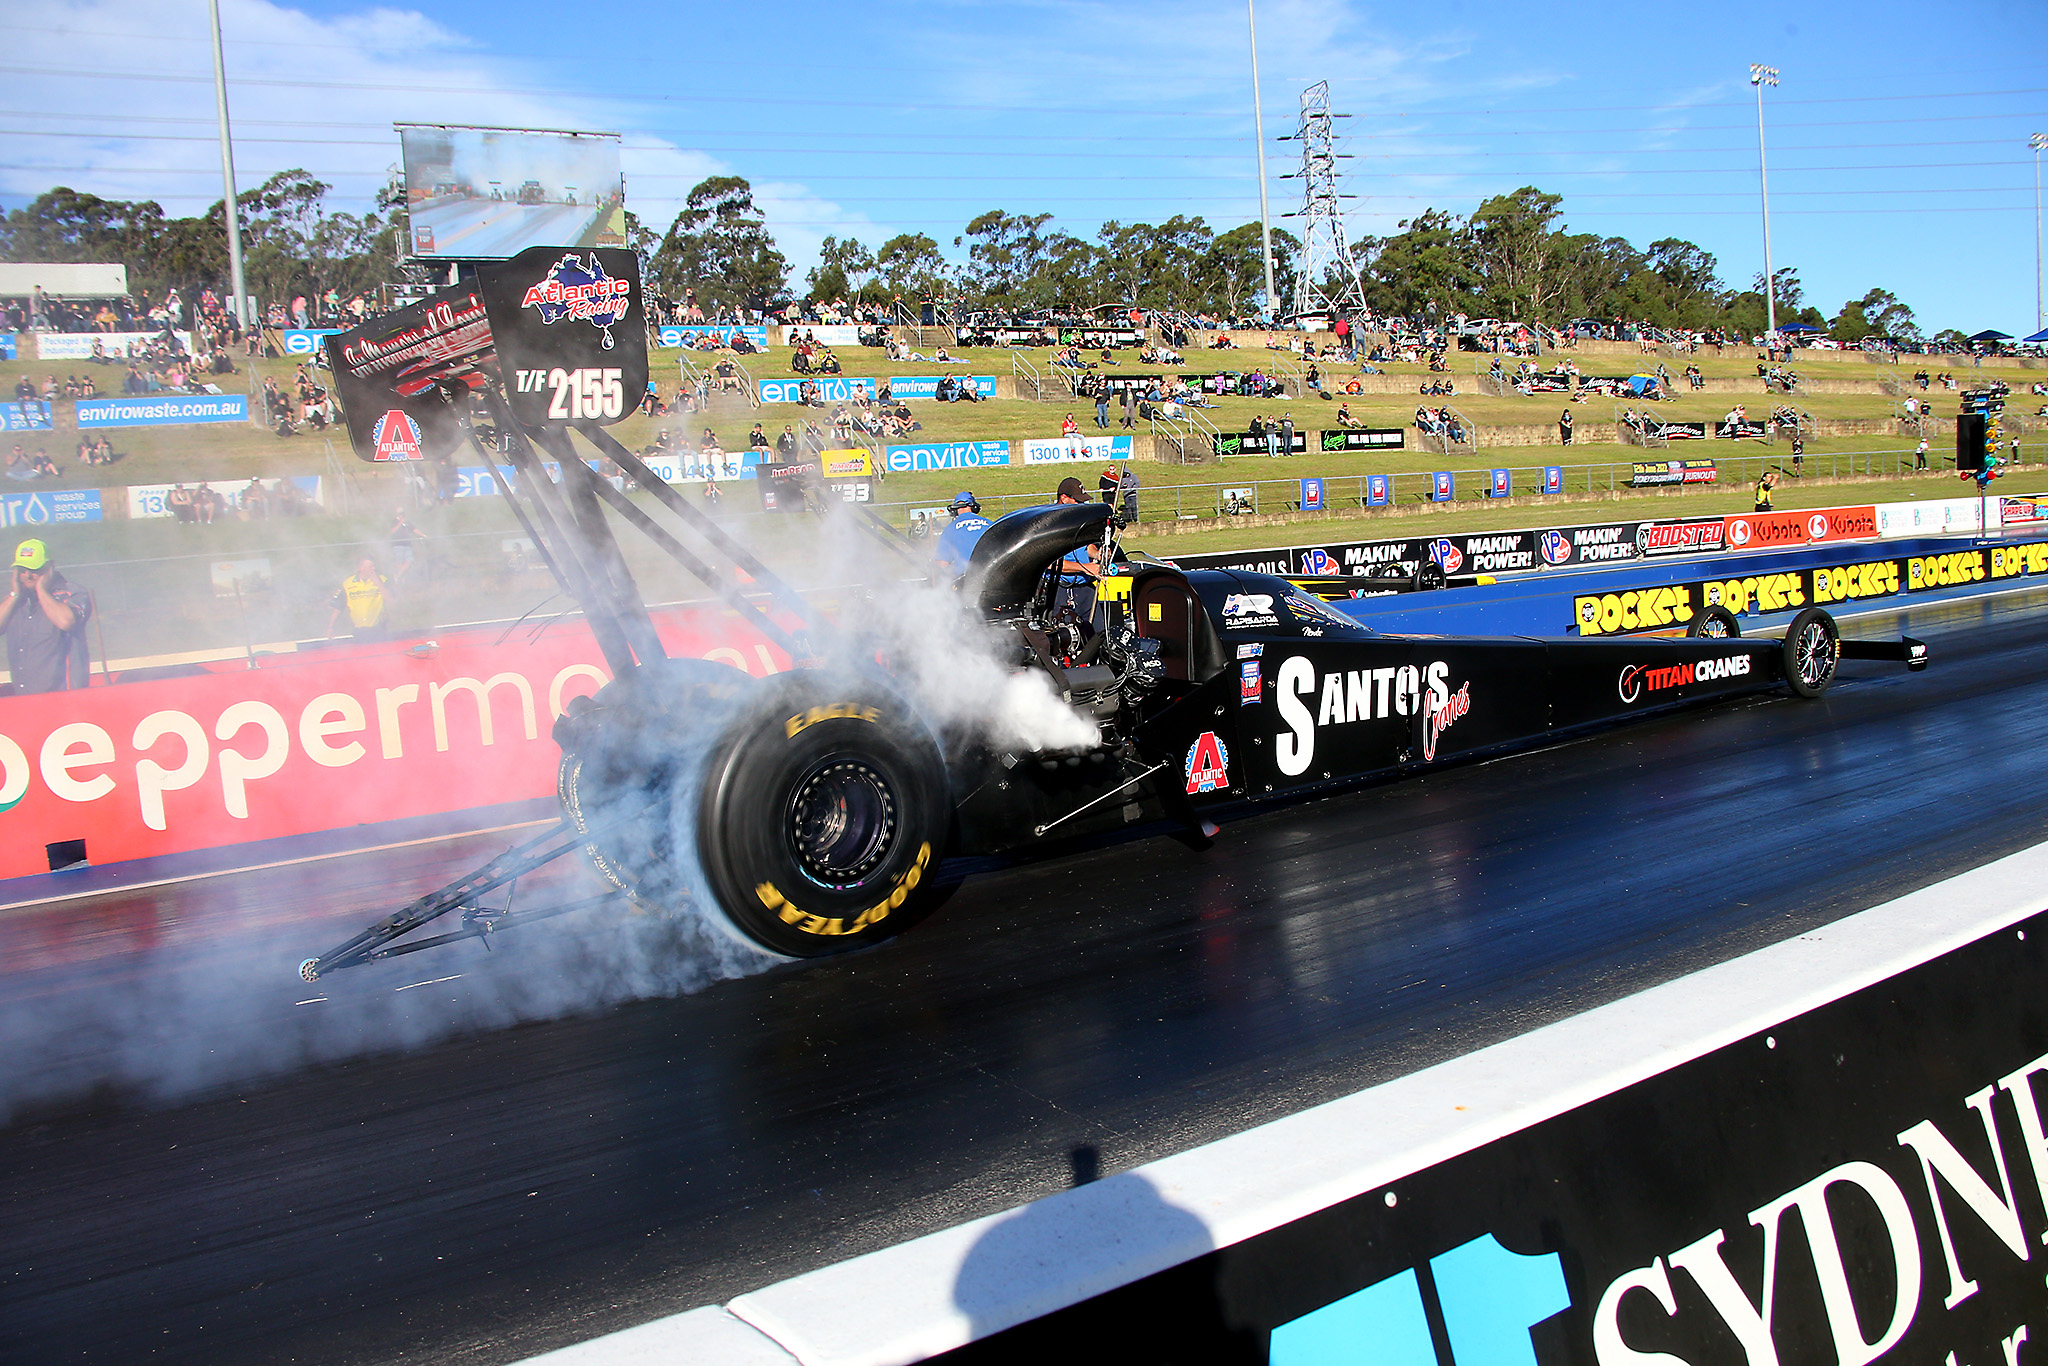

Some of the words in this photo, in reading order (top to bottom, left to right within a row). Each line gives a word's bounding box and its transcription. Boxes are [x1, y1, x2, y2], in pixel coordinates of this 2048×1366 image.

[521, 279, 631, 309] Atlantic
[566, 296, 630, 321] Racing
[515, 369, 547, 393] T/F
[548, 367, 624, 420] 2155
[78, 402, 241, 422] envirowaste.com.au
[380, 442, 416, 452] ATLANTIC
[981, 442, 1001, 450] waste
[982, 449, 1009, 457] services
[1030, 446, 1061, 461] 1300
[1096, 445, 1109, 458] 15
[982, 457, 1001, 465] group
[53, 492, 85, 502] waste
[842, 483, 870, 503] 33
[54, 501, 101, 512] services
[55, 510, 87, 522] group
[955, 518, 990, 530] OFFICIAL
[1752, 519, 1802, 541] Kubota
[1830, 514, 1874, 534] Kubota
[1573, 527, 1623, 546] MAKIN'
[1647, 522, 1725, 547] BOOSTED
[1344, 543, 1407, 566] MAKIN'
[1466, 535, 1522, 556] MAKIN'
[1579, 542, 1634, 562] POWER!
[1472, 551, 1534, 572] POWER!
[1225, 615, 1279, 626] RAPISARDA
[1143, 660, 1162, 669] MSD
[1645, 663, 1695, 692] TITAN
[1694, 654, 1751, 683] CRANES
[1245, 676, 1258, 689] TOP
[1244, 688, 1258, 698] FUEL
[1275, 655, 1450, 777] SANTO'S
[1423, 680, 1471, 762] Cranes
[1190, 766, 1224, 785] ATLANTIC
